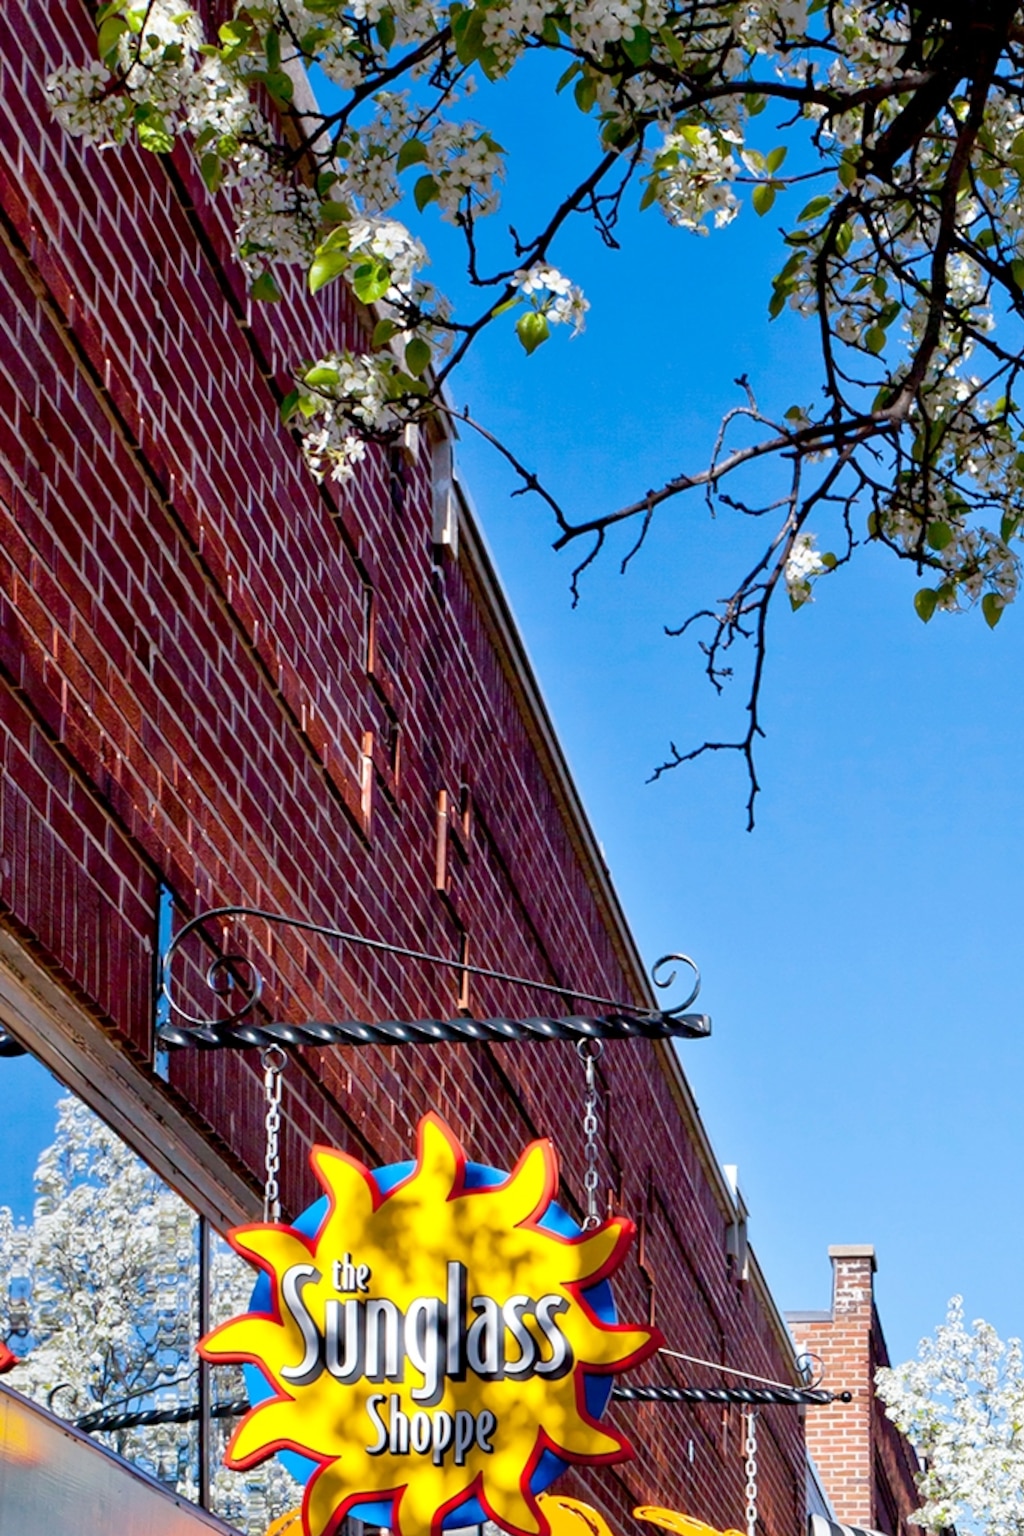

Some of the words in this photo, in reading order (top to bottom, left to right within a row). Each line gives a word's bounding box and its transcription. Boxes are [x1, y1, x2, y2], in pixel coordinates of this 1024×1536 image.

[331, 1253, 370, 1292] the
[280, 1261, 573, 1405] Sunglass
[366, 1394, 496, 1465] Shoppe
